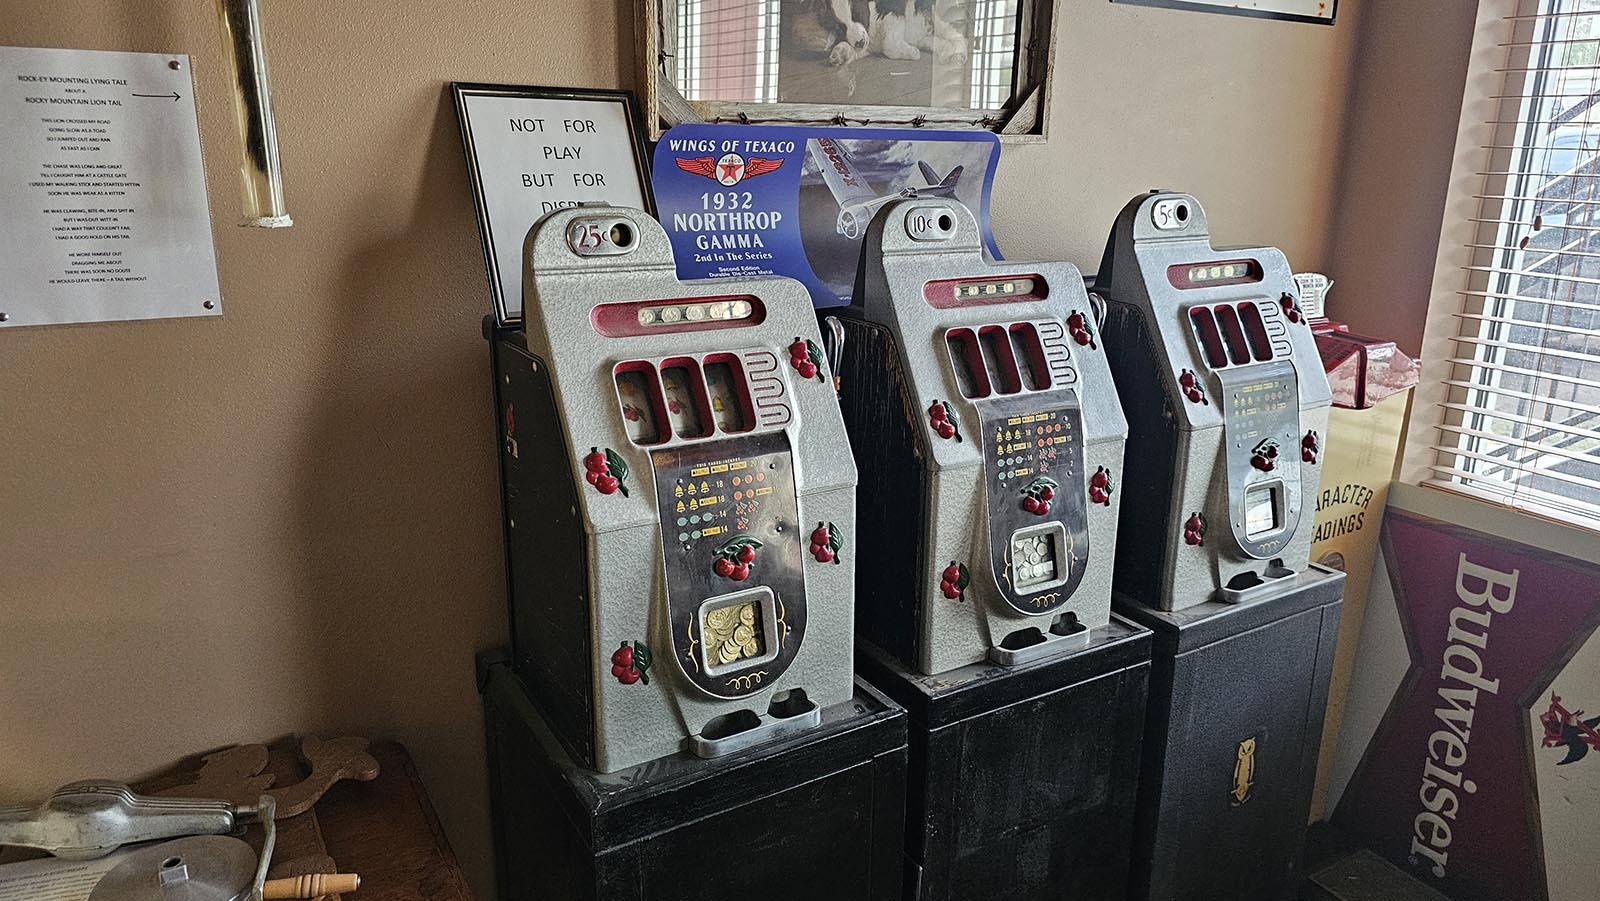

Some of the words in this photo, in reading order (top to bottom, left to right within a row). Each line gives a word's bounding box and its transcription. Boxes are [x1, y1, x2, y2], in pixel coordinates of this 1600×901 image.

[510, 119, 544, 132] NOT
[564, 120, 596, 133] FOR
[543, 146, 581, 159] PLAY
[670, 140, 715, 152] WINGS
[722, 140, 739, 152] OF
[745, 141, 794, 153] TEXACO
[522, 174, 554, 187] BUT
[573, 174, 606, 187] FOR
[701, 192, 752, 210] 1932
[674, 212, 782, 232] NORTHROP
[696, 234, 764, 250] GAMMA
[694, 254, 712, 262] 2nd
[726, 252, 743, 260] The
[745, 252, 772, 260] Series
[1315, 484, 1373, 511] ARACTER
[1311, 512, 1364, 544] ADINGS
[1410, 552, 1520, 878] Budweiser
